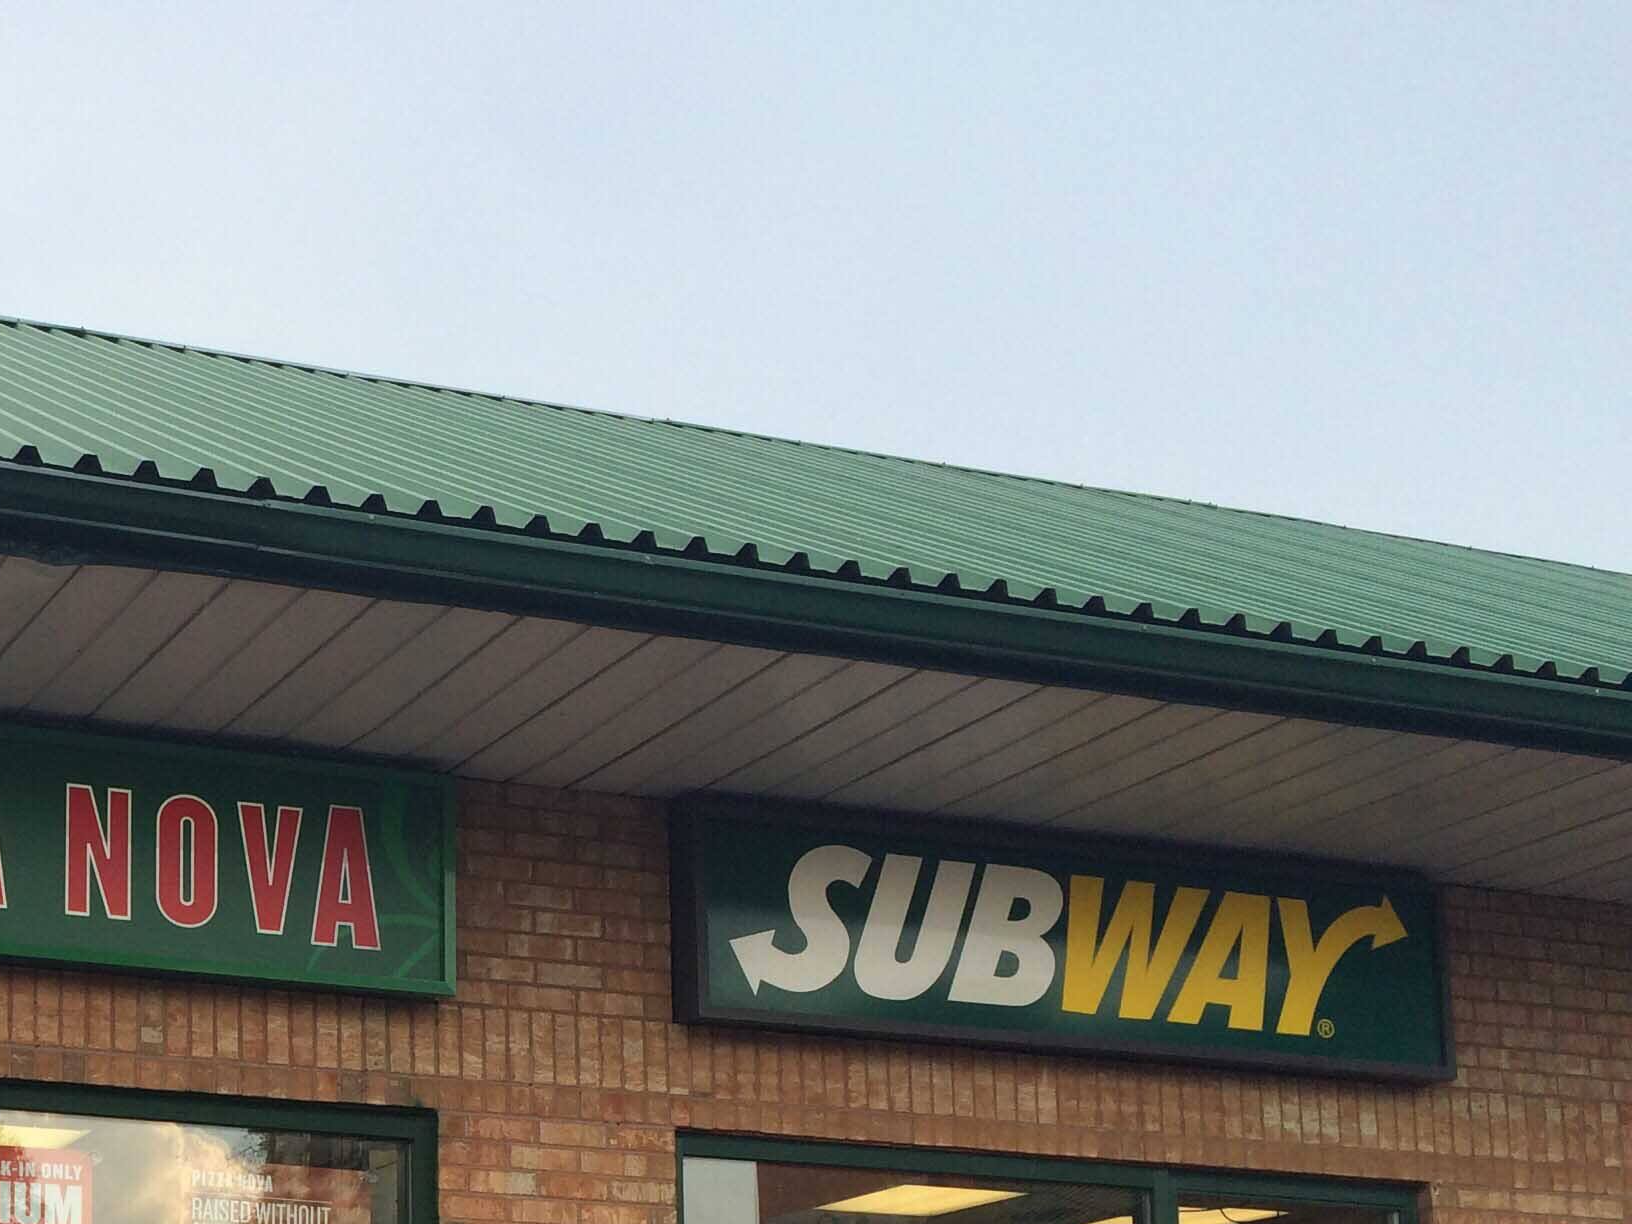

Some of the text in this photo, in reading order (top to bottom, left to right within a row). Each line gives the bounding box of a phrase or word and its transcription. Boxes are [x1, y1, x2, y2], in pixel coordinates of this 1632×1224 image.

[64, 782, 381, 952] NOVA
[729, 844, 1409, 1037] SUBWAY
[41, 1162, 81, 1181] ONLY
[192, 1169, 273, 1192] PIZZA NOVA
[192, 1197, 251, 1223] RAISED
